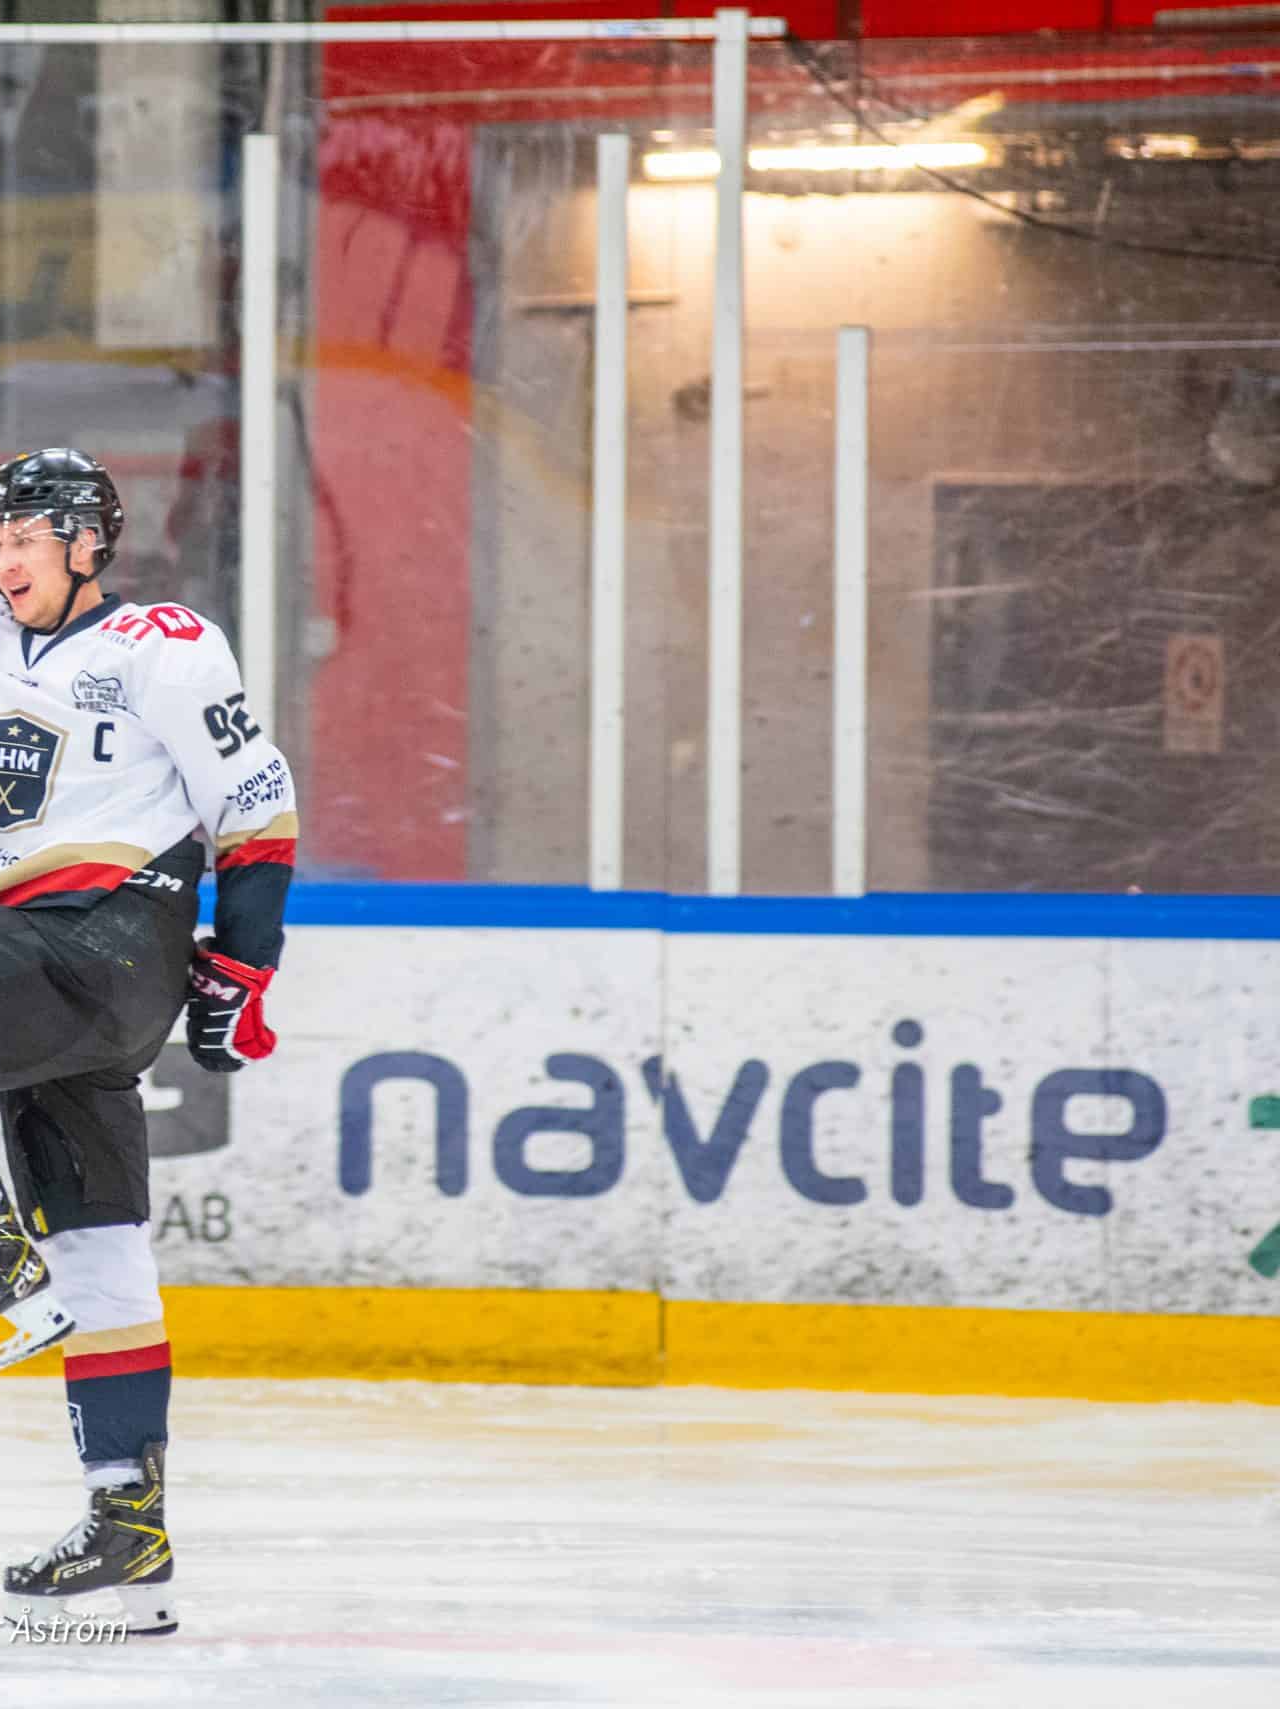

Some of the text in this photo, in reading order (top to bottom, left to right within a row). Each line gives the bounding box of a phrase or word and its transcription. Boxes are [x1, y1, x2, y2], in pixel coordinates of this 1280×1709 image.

[94, 721, 116, 763] C
[203, 691, 262, 760] 92
[236, 759, 282, 798] JOIN TO
[122, 868, 184, 893] CM
[337, 1018, 1168, 1216] navcite
[156, 1193, 232, 1243] AB
